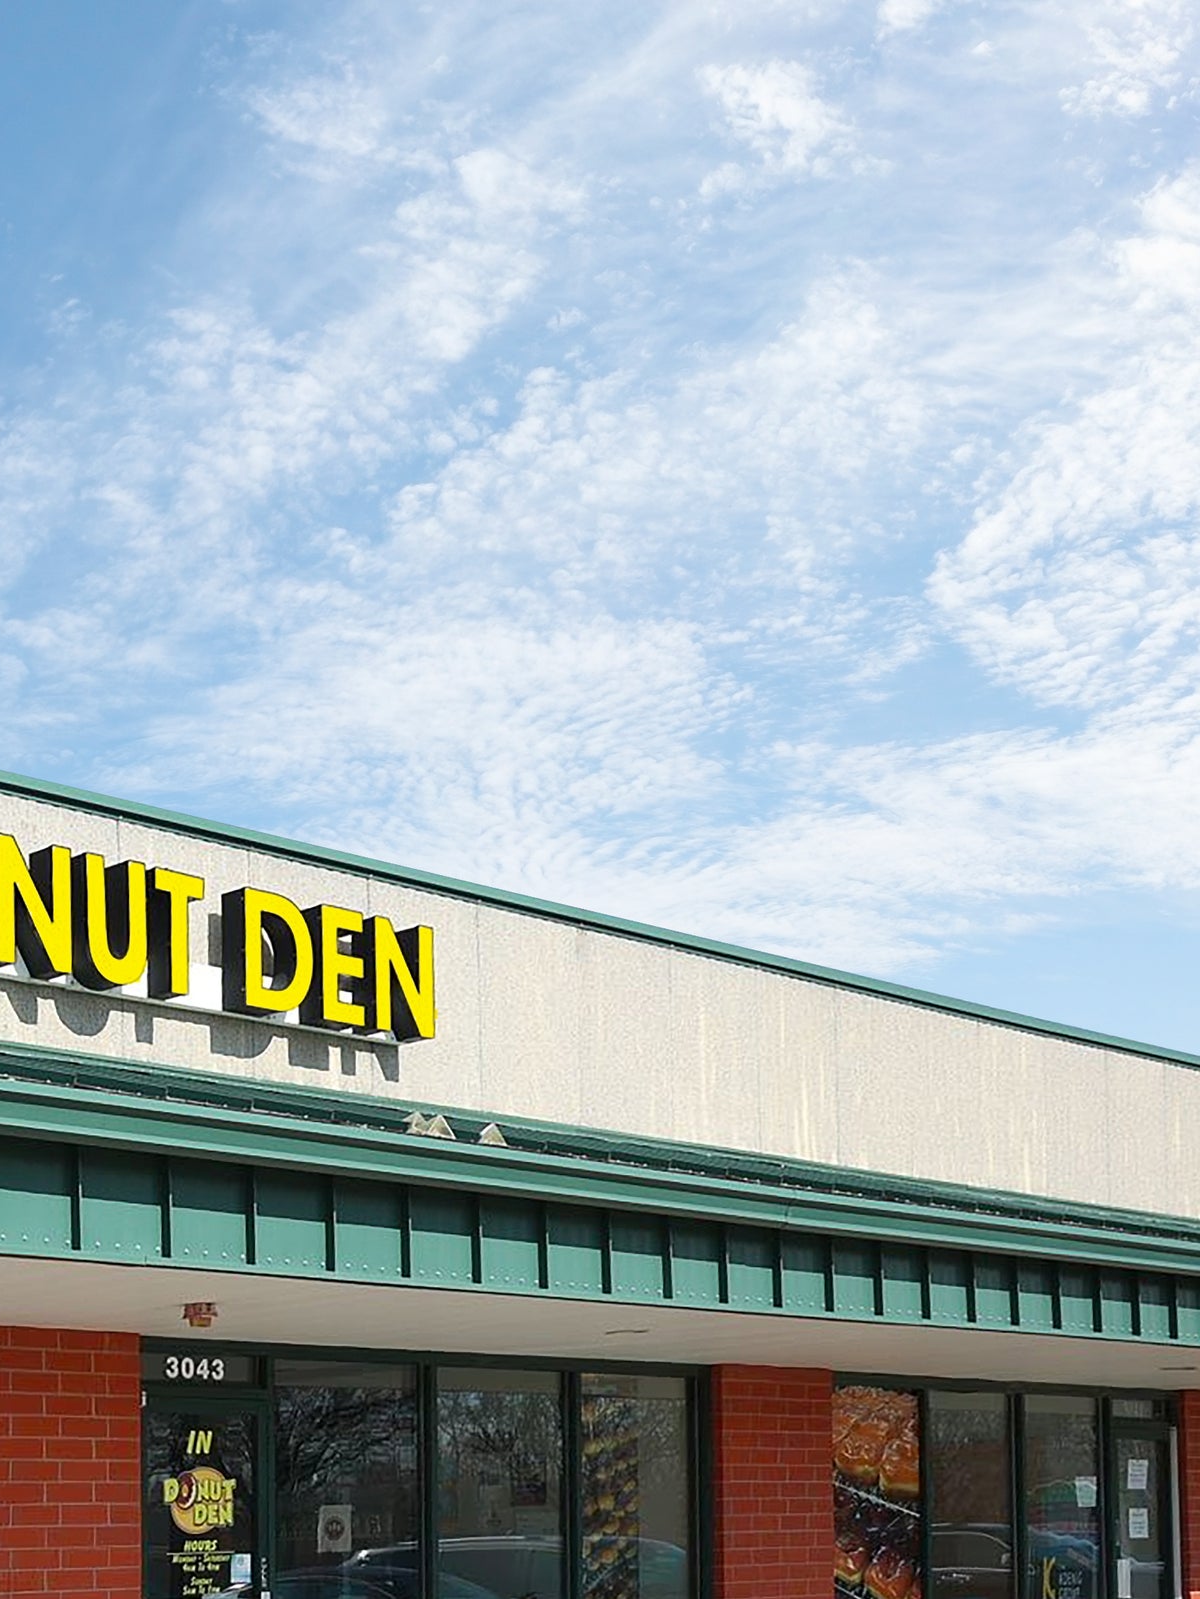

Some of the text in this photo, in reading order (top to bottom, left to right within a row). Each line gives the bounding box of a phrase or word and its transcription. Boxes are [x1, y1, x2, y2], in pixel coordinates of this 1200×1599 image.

[244, 887, 435, 1040] DEN
[165, 1356, 225, 1380] 3043
[186, 1430, 213, 1454] IN
[163, 1474, 237, 1509] DONUT
[193, 1501, 234, 1527] DEN
[184, 1540, 218, 1552] HOURS
